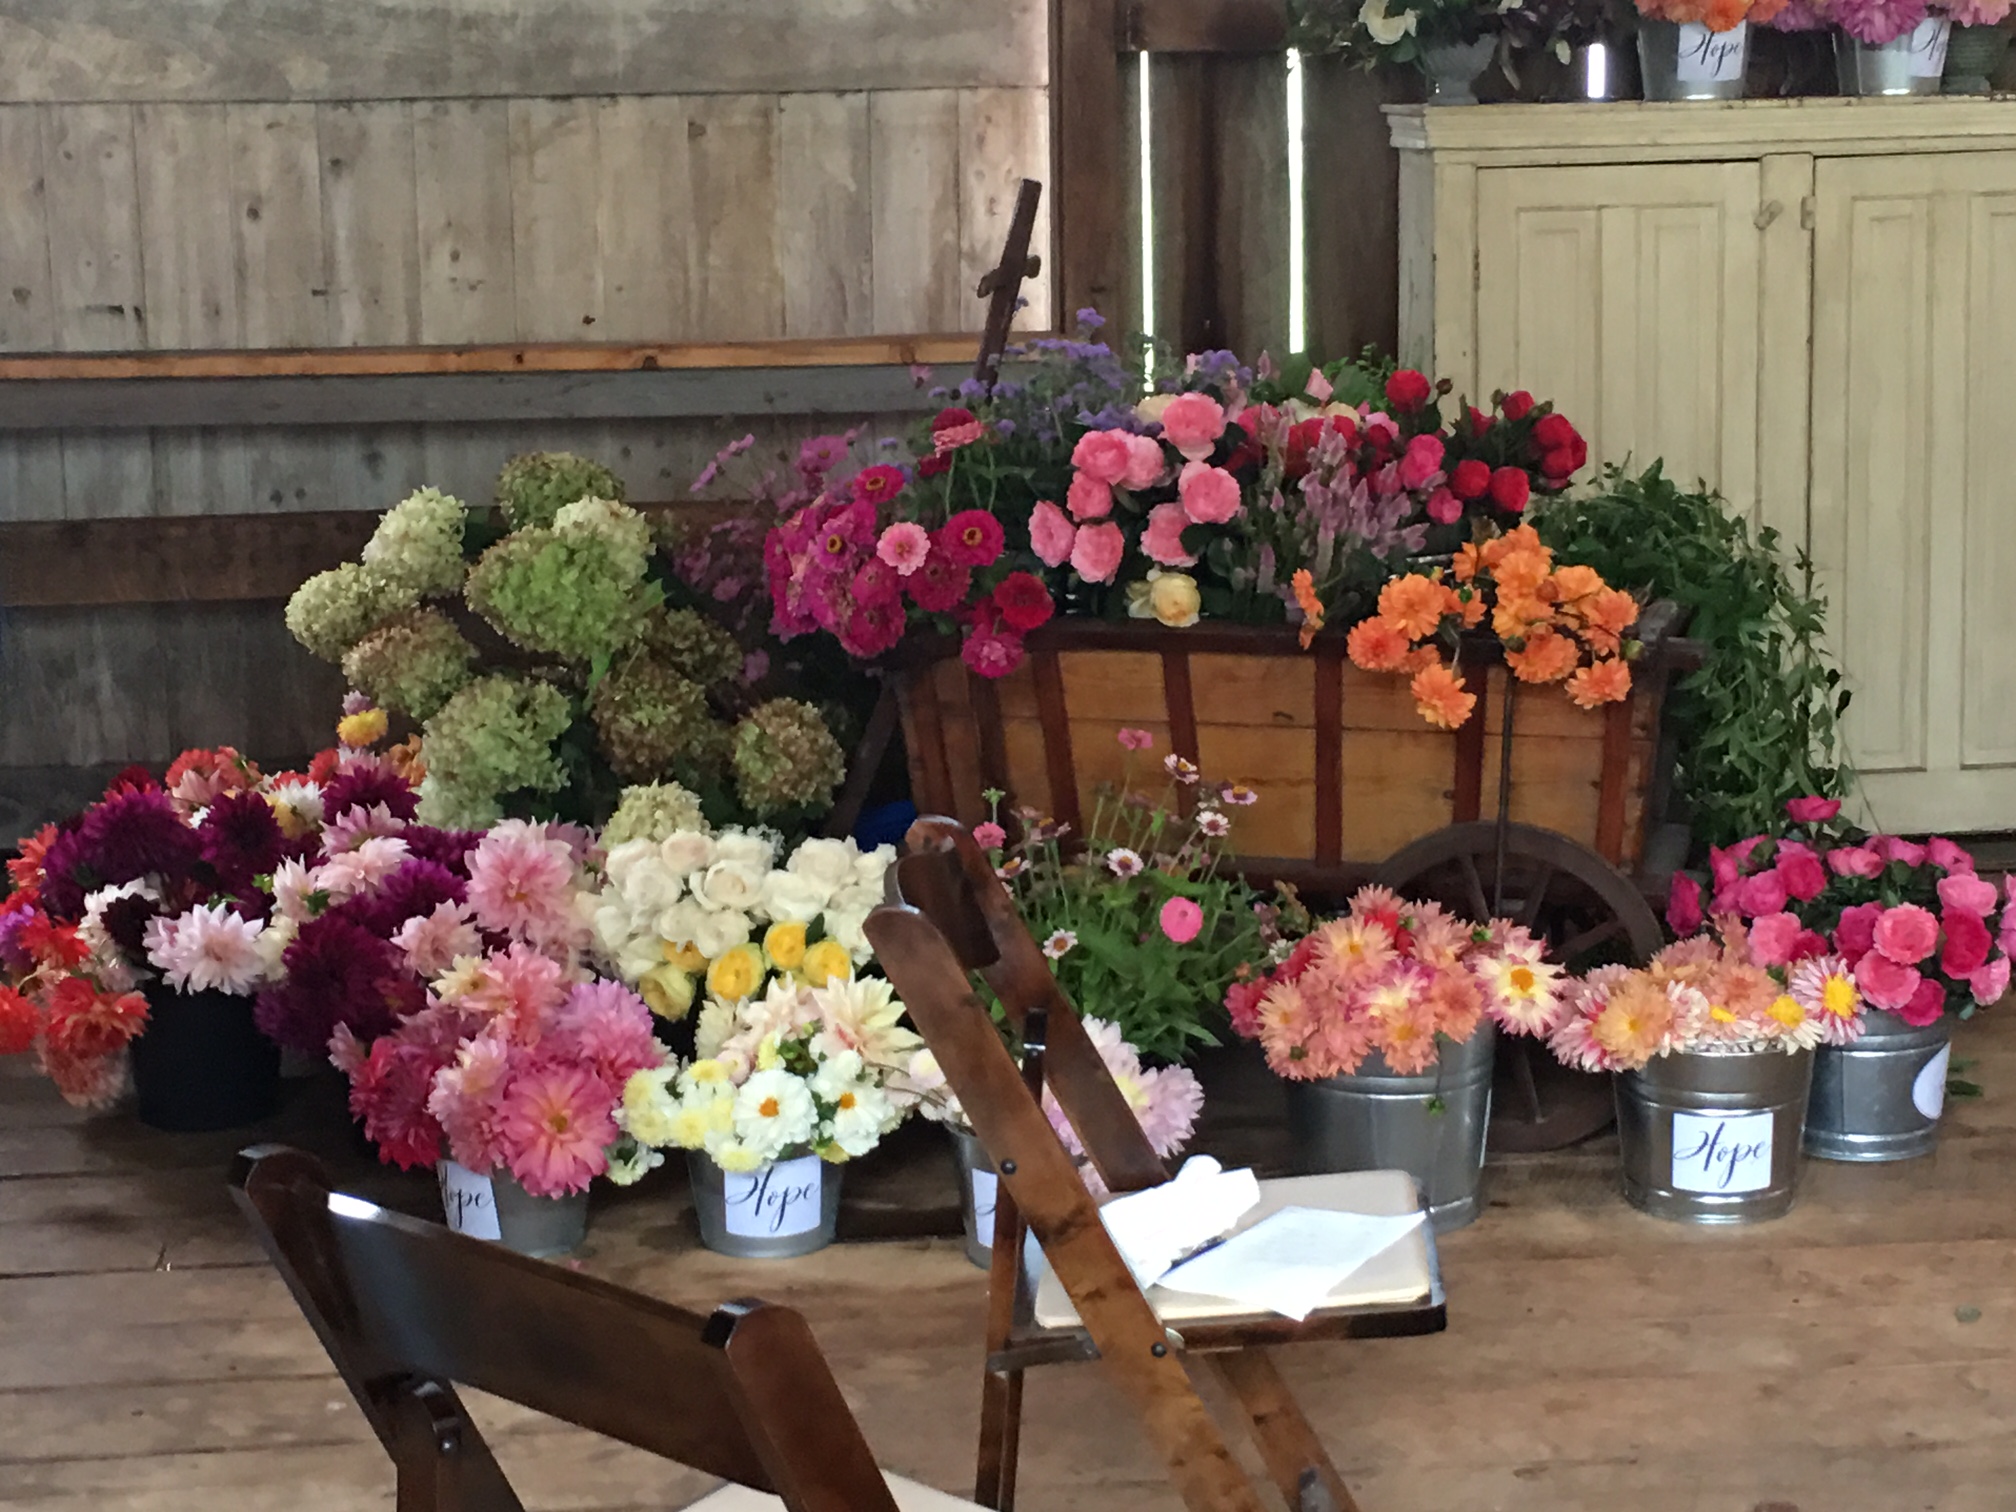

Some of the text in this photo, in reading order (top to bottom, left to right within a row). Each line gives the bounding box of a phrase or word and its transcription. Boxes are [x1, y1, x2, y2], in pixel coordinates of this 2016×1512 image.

[1678, 31, 1741, 78] Hope
[1674, 1122, 1769, 1188] Hope
[725, 1167, 819, 1232] Hope
